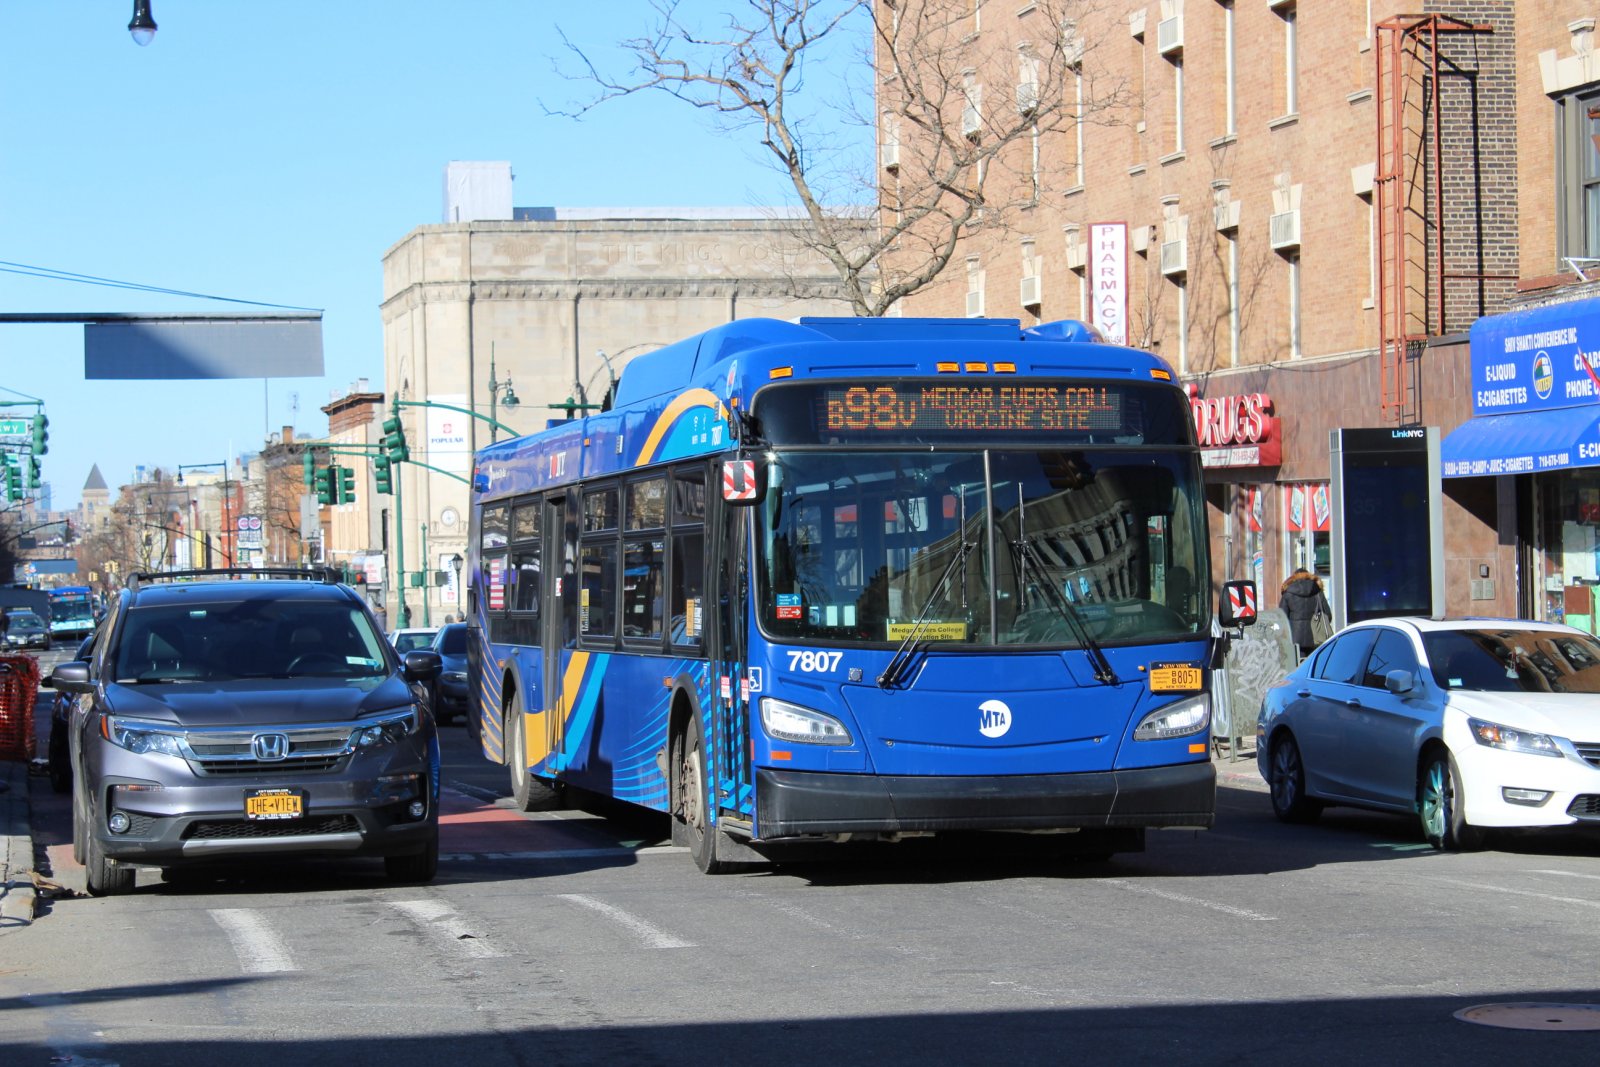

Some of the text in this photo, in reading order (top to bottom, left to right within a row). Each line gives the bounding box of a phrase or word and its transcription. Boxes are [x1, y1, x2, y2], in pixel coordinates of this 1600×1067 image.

[603, 243, 646, 262] THE
[659, 242, 723, 262] KINGS
[1101, 226, 1117, 332] PHARMACY
[1534, 329, 1568, 349] CONVENIENCE
[1568, 327, 1577, 344] INC
[1485, 363, 1516, 382] E-LIQUID
[921, 387, 994, 409] MEDGAR
[1000, 387, 1058, 409] EVERS
[1065, 387, 1112, 410] COLL
[1477, 386, 1528, 407] E-CIGARETTES
[1566, 378, 1593, 399] PHONE
[945, 410, 1091, 430] VACCINE SITE
[1193, 393, 1266, 446] DRUGS
[1391, 430, 1424, 438] LinkNYC
[1458, 460, 1470, 475] BEER
[1472, 460, 1487, 474] CANDY
[1505, 456, 1533, 472] CIGARETTES
[891, 627, 916, 636] Medga
[937, 626, 963, 635] College
[787, 651, 843, 673] 7807
[1177, 670, 1198, 684] 8051
[978, 709, 1006, 730] MTA
[251, 799, 268, 813] THE
